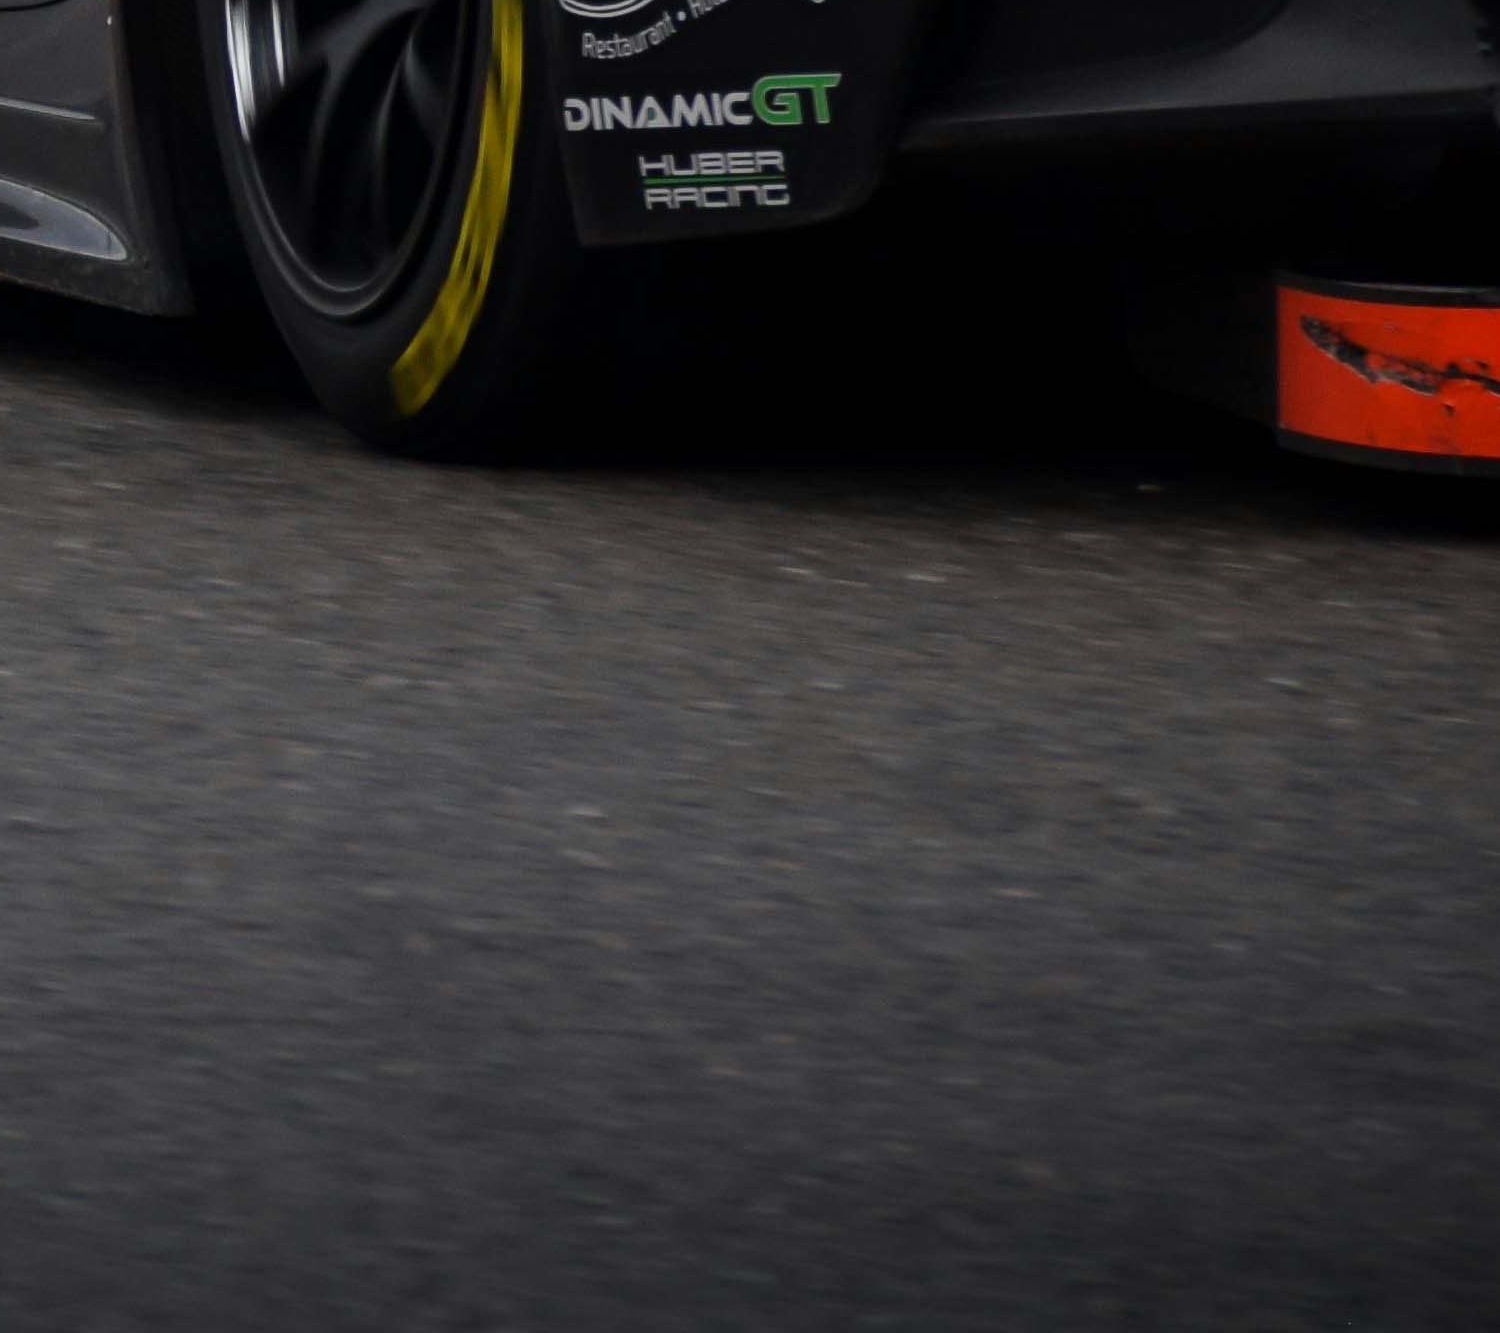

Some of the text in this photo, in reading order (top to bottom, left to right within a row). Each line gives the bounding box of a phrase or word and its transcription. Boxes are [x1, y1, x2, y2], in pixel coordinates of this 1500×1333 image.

[581, 10, 678, 60] Restaurant
[638, 150, 786, 177] HUBER
[643, 184, 791, 210] RACING
